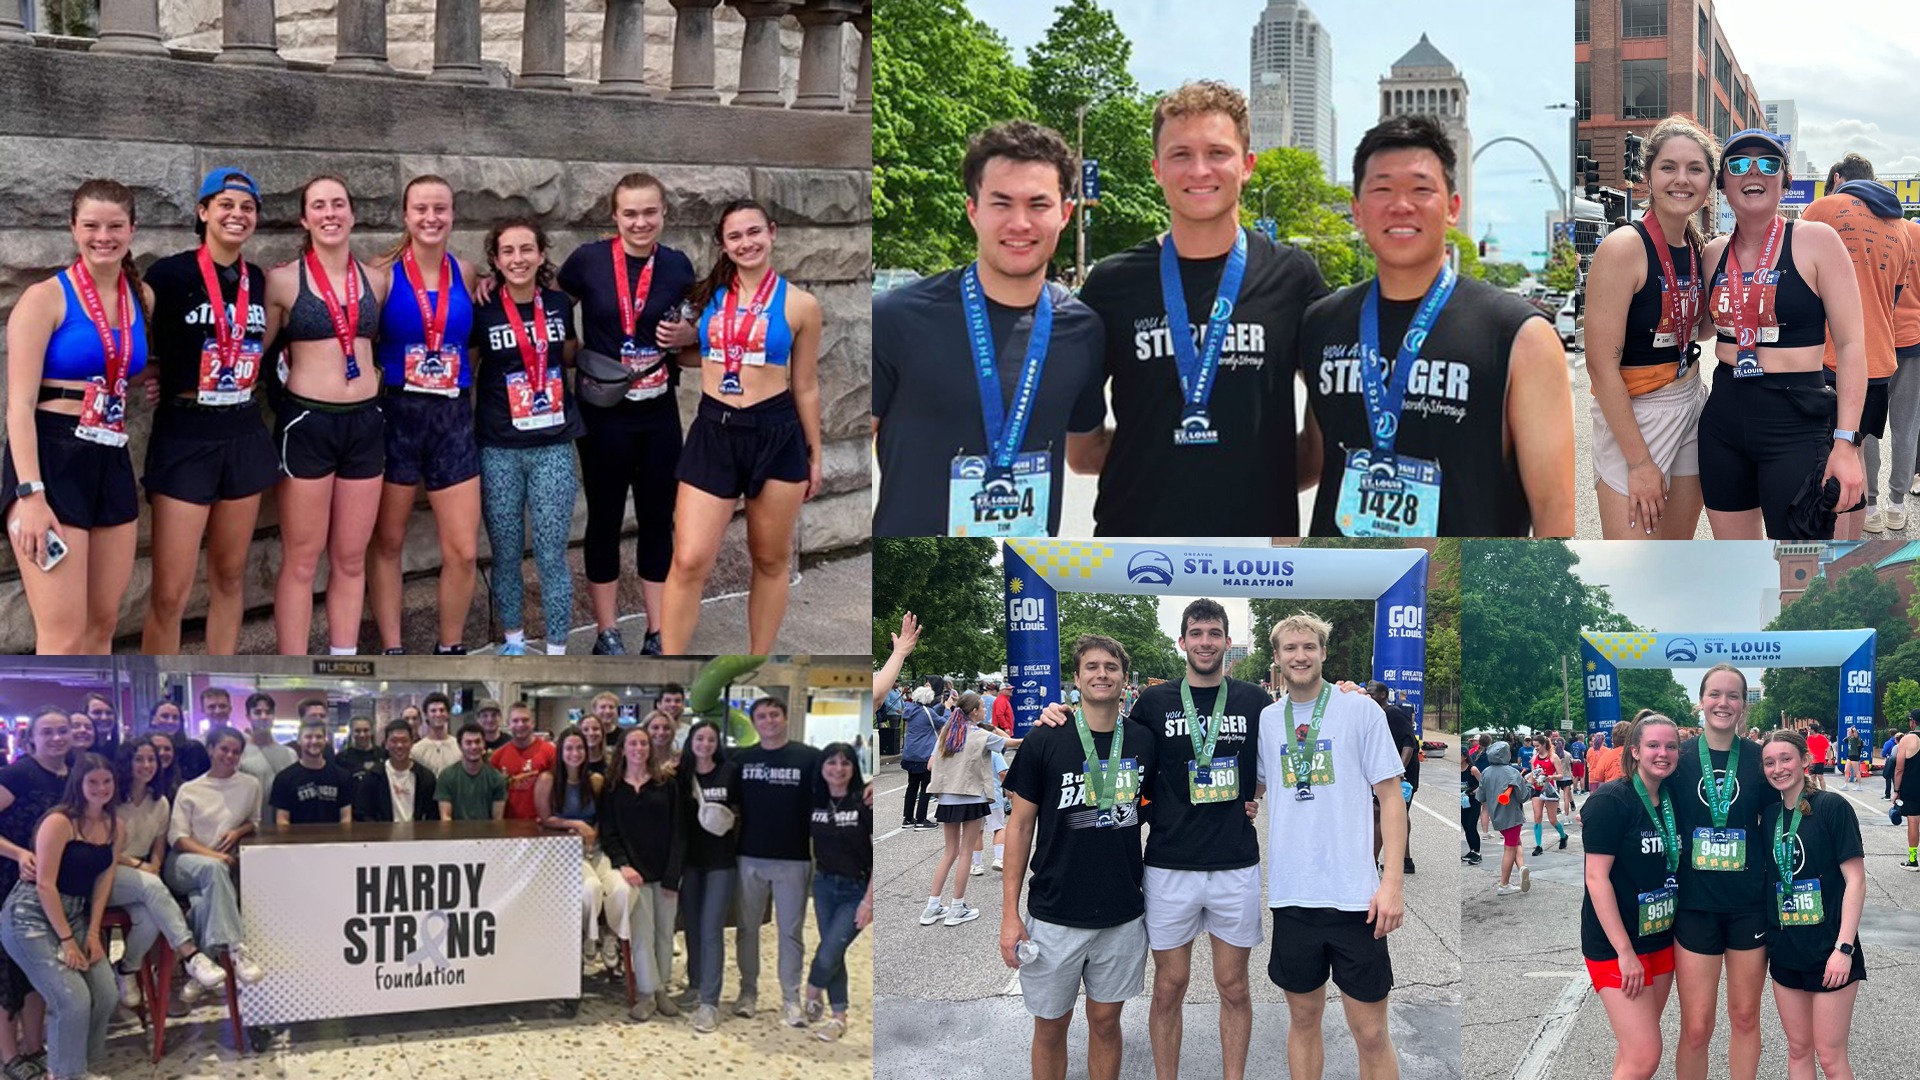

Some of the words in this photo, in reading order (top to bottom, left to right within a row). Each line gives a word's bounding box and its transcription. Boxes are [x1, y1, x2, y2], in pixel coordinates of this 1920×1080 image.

[1721, 212, 1736, 220] NIS
[1763, 236, 1775, 257] LOUIS
[965, 270, 978, 300] 2024
[1426, 286, 1445, 316] LOUIS
[1734, 300, 1742, 320] 2024
[970, 304, 993, 378] FINISHER
[210, 359, 254, 379] 290
[1005, 420, 1021, 452] LOUIS
[1015, 358, 1038, 420] MARATHON
[1357, 487, 1419, 527] 1428
[1183, 558, 1218, 575] ST.
[1223, 560, 1295, 577] LOUIS
[1222, 578, 1295, 588] MARATHON
[1009, 597, 1045, 622] GO!
[1388, 605, 1423, 630] GO!
[1010, 621, 1020, 632] St.
[1388, 628, 1399, 638] St.
[1704, 642, 1728, 654] ST.
[1731, 641, 1781, 653] LOUIS
[1023, 664, 1051, 672] GREATER
[1384, 669, 1396, 678] GO!
[1586, 673, 1611, 692] GO!
[1848, 670, 1872, 687] GO!
[1185, 699, 1193, 715] 2024
[1189, 716, 1202, 753] FINISHER
[1211, 720, 1219, 735] LOUIS
[1707, 780, 1718, 817] FINISHER
[1666, 816, 1676, 851] FINISHER
[1701, 840, 1738, 857] 9491
[356, 862, 487, 915] HARDY
[1647, 898, 1675, 921] 9514
